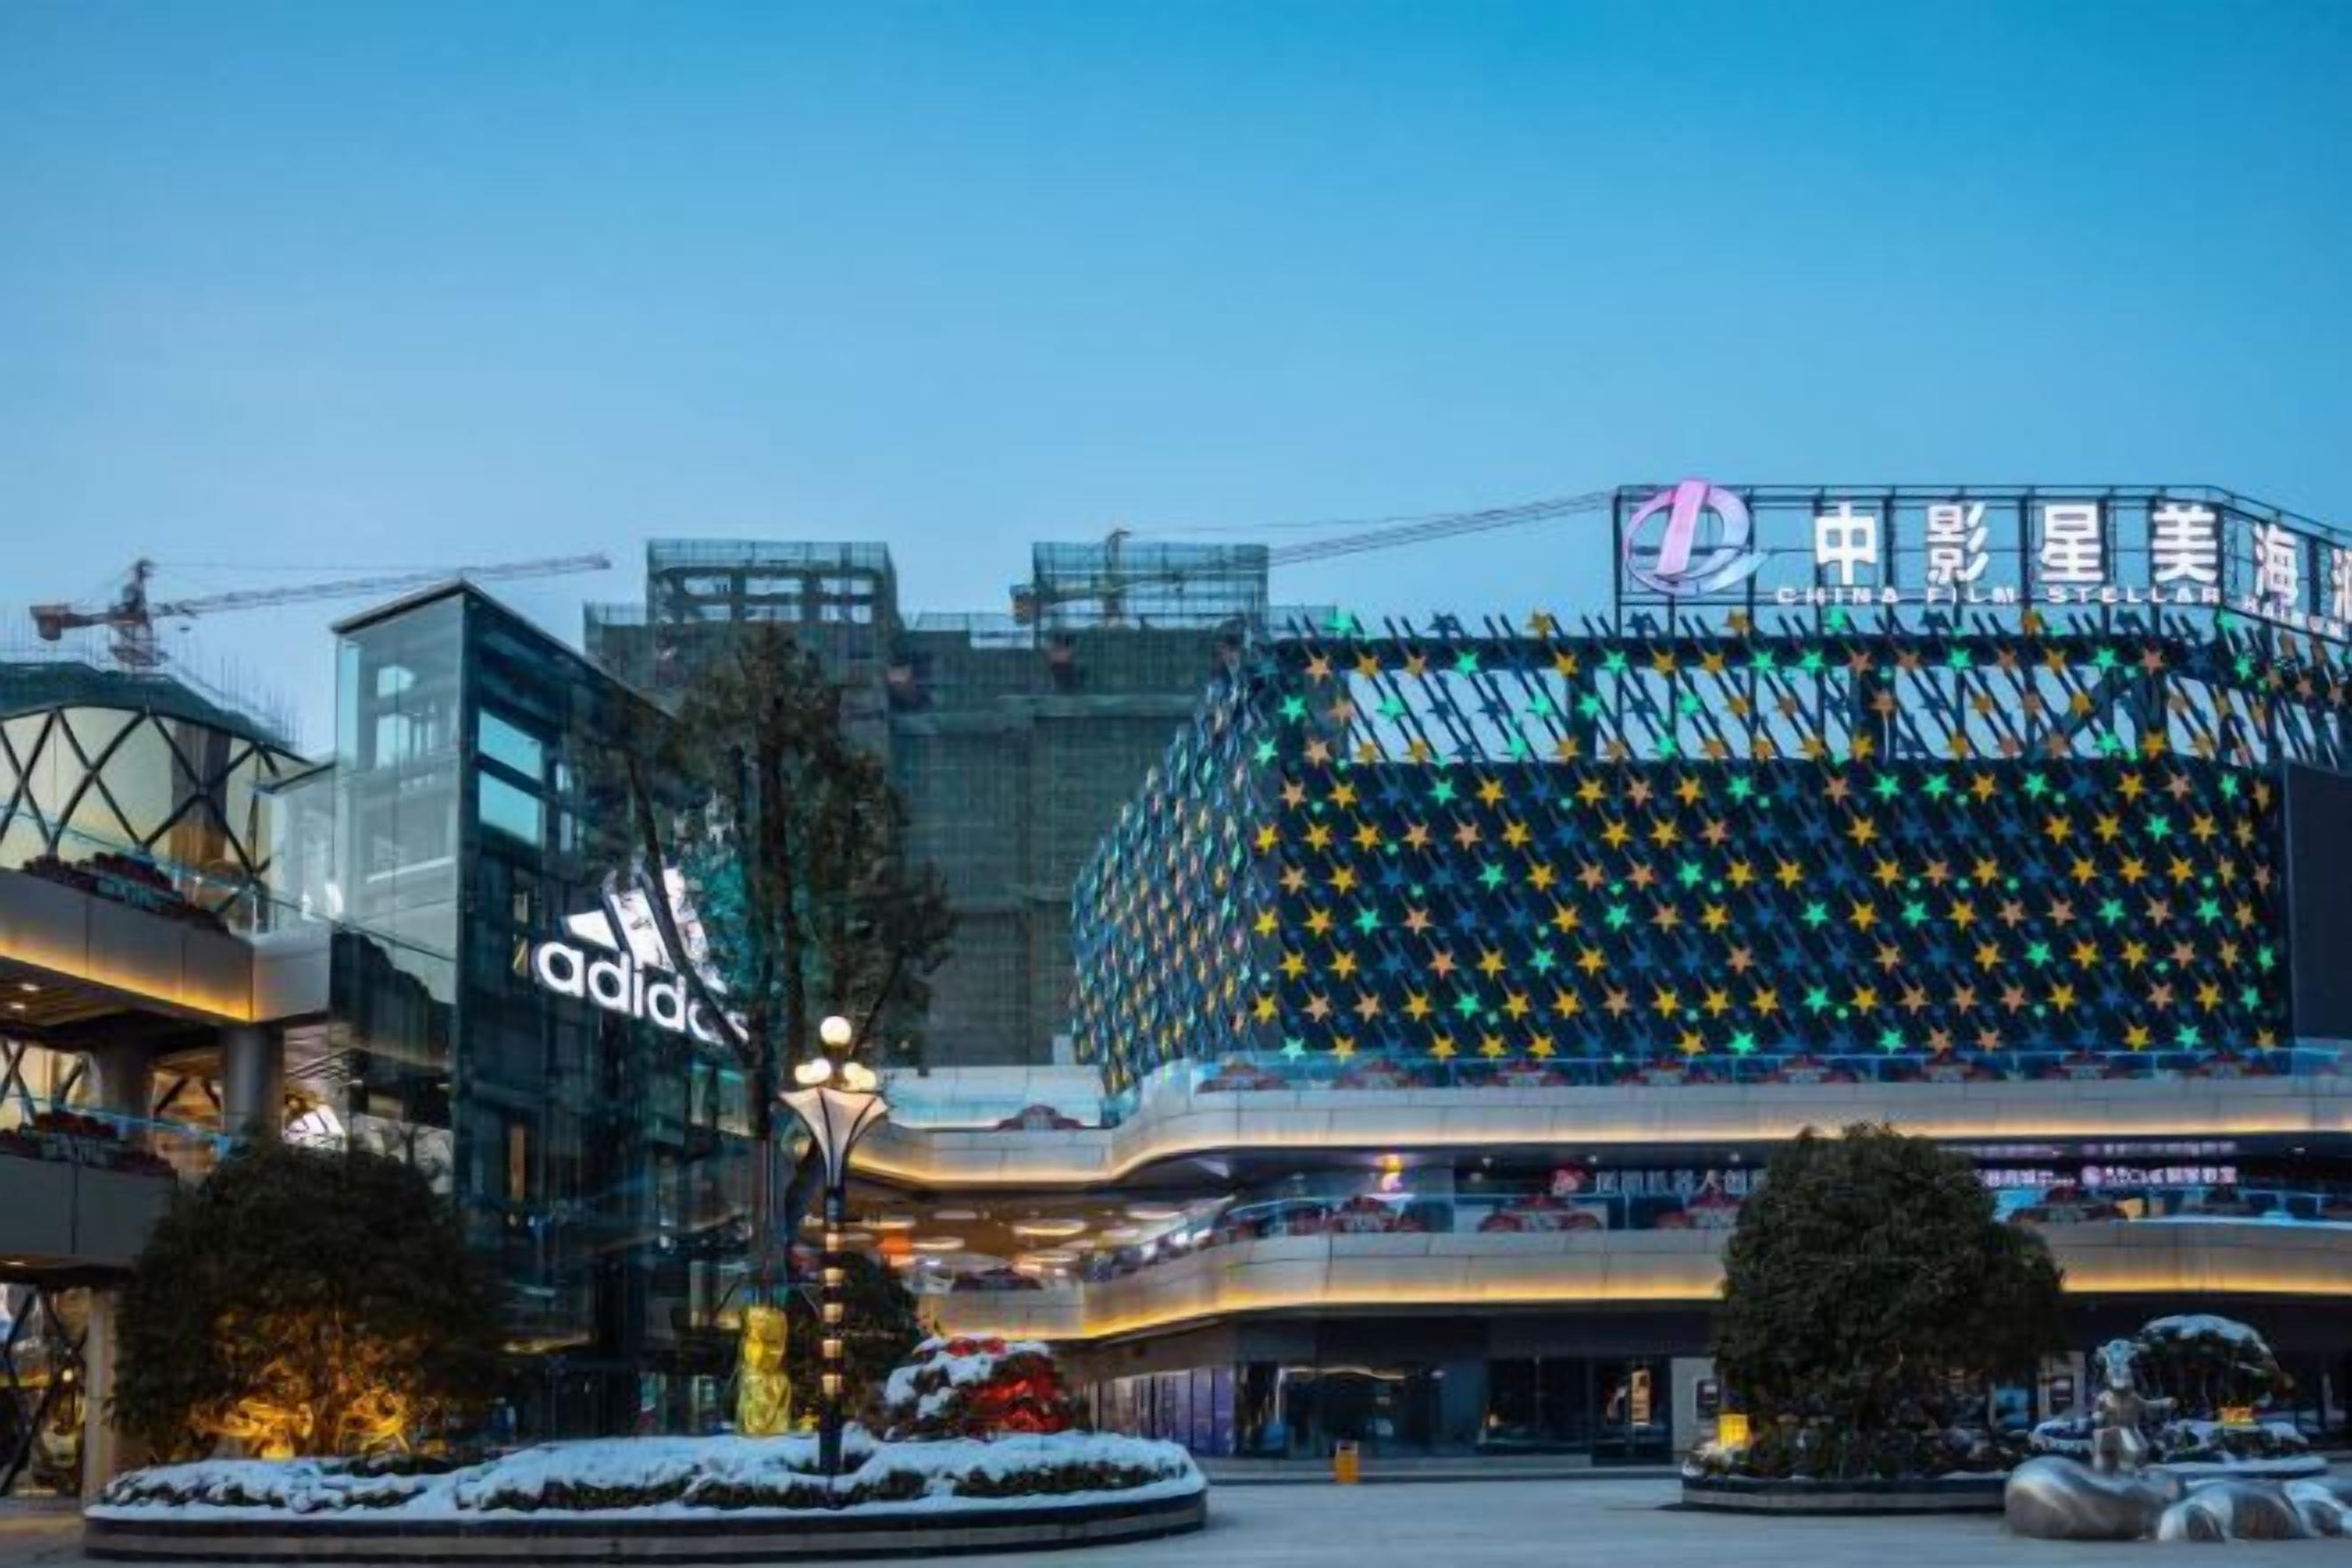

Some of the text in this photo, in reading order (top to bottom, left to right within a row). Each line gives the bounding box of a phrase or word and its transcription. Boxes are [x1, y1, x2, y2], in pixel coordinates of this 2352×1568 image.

[1814, 502, 2217, 586] 中影星美
[1776, 585, 2220, 604] CHINA FILM STELLAR
